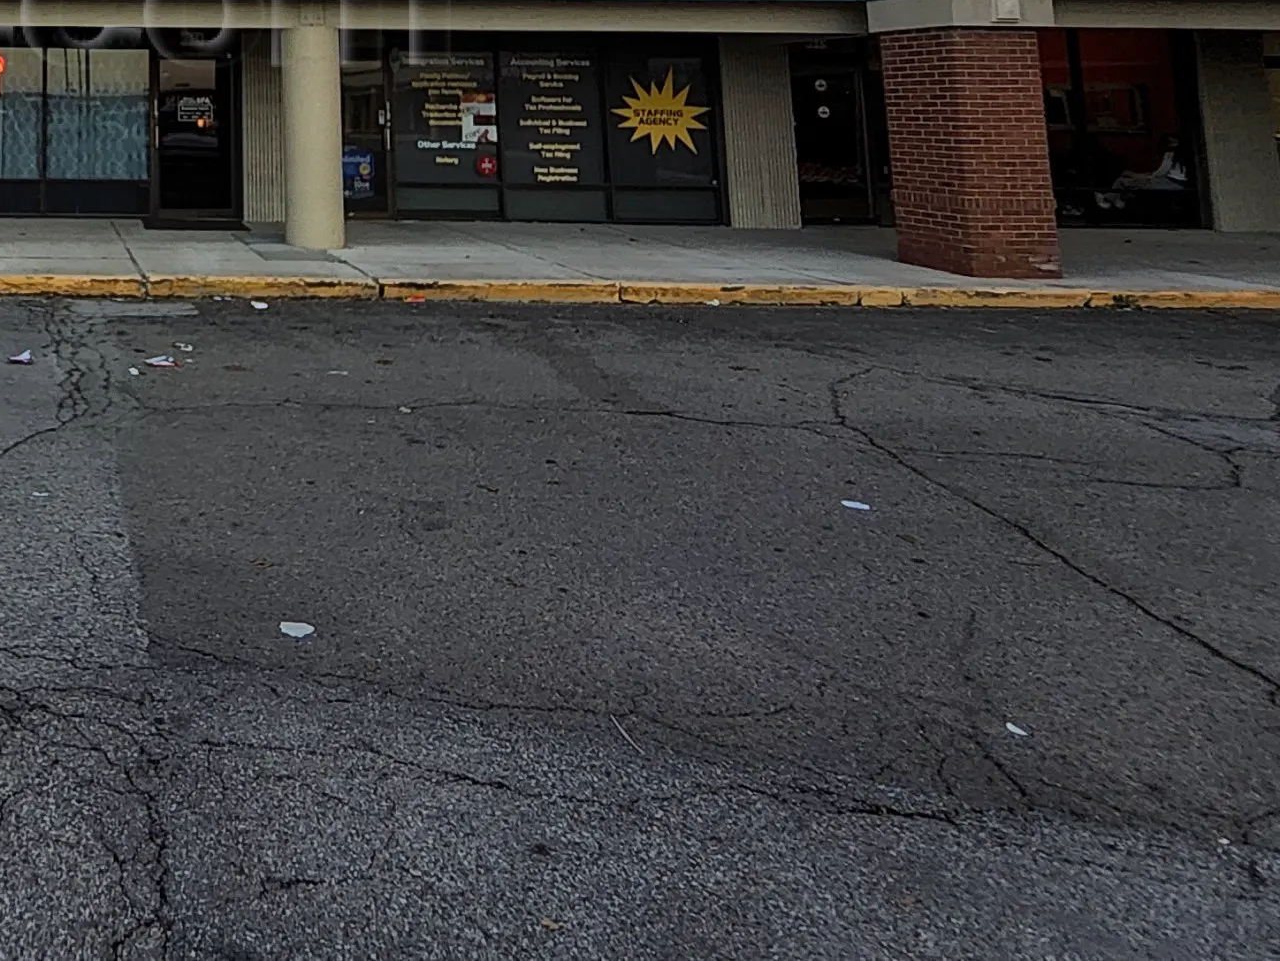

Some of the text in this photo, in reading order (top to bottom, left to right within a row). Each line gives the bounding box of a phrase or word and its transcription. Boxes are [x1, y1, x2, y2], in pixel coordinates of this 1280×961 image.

[633, 109, 684, 118] STAFFING
[638, 117, 679, 126] AGENCY
[417, 140, 477, 149] Other Services
